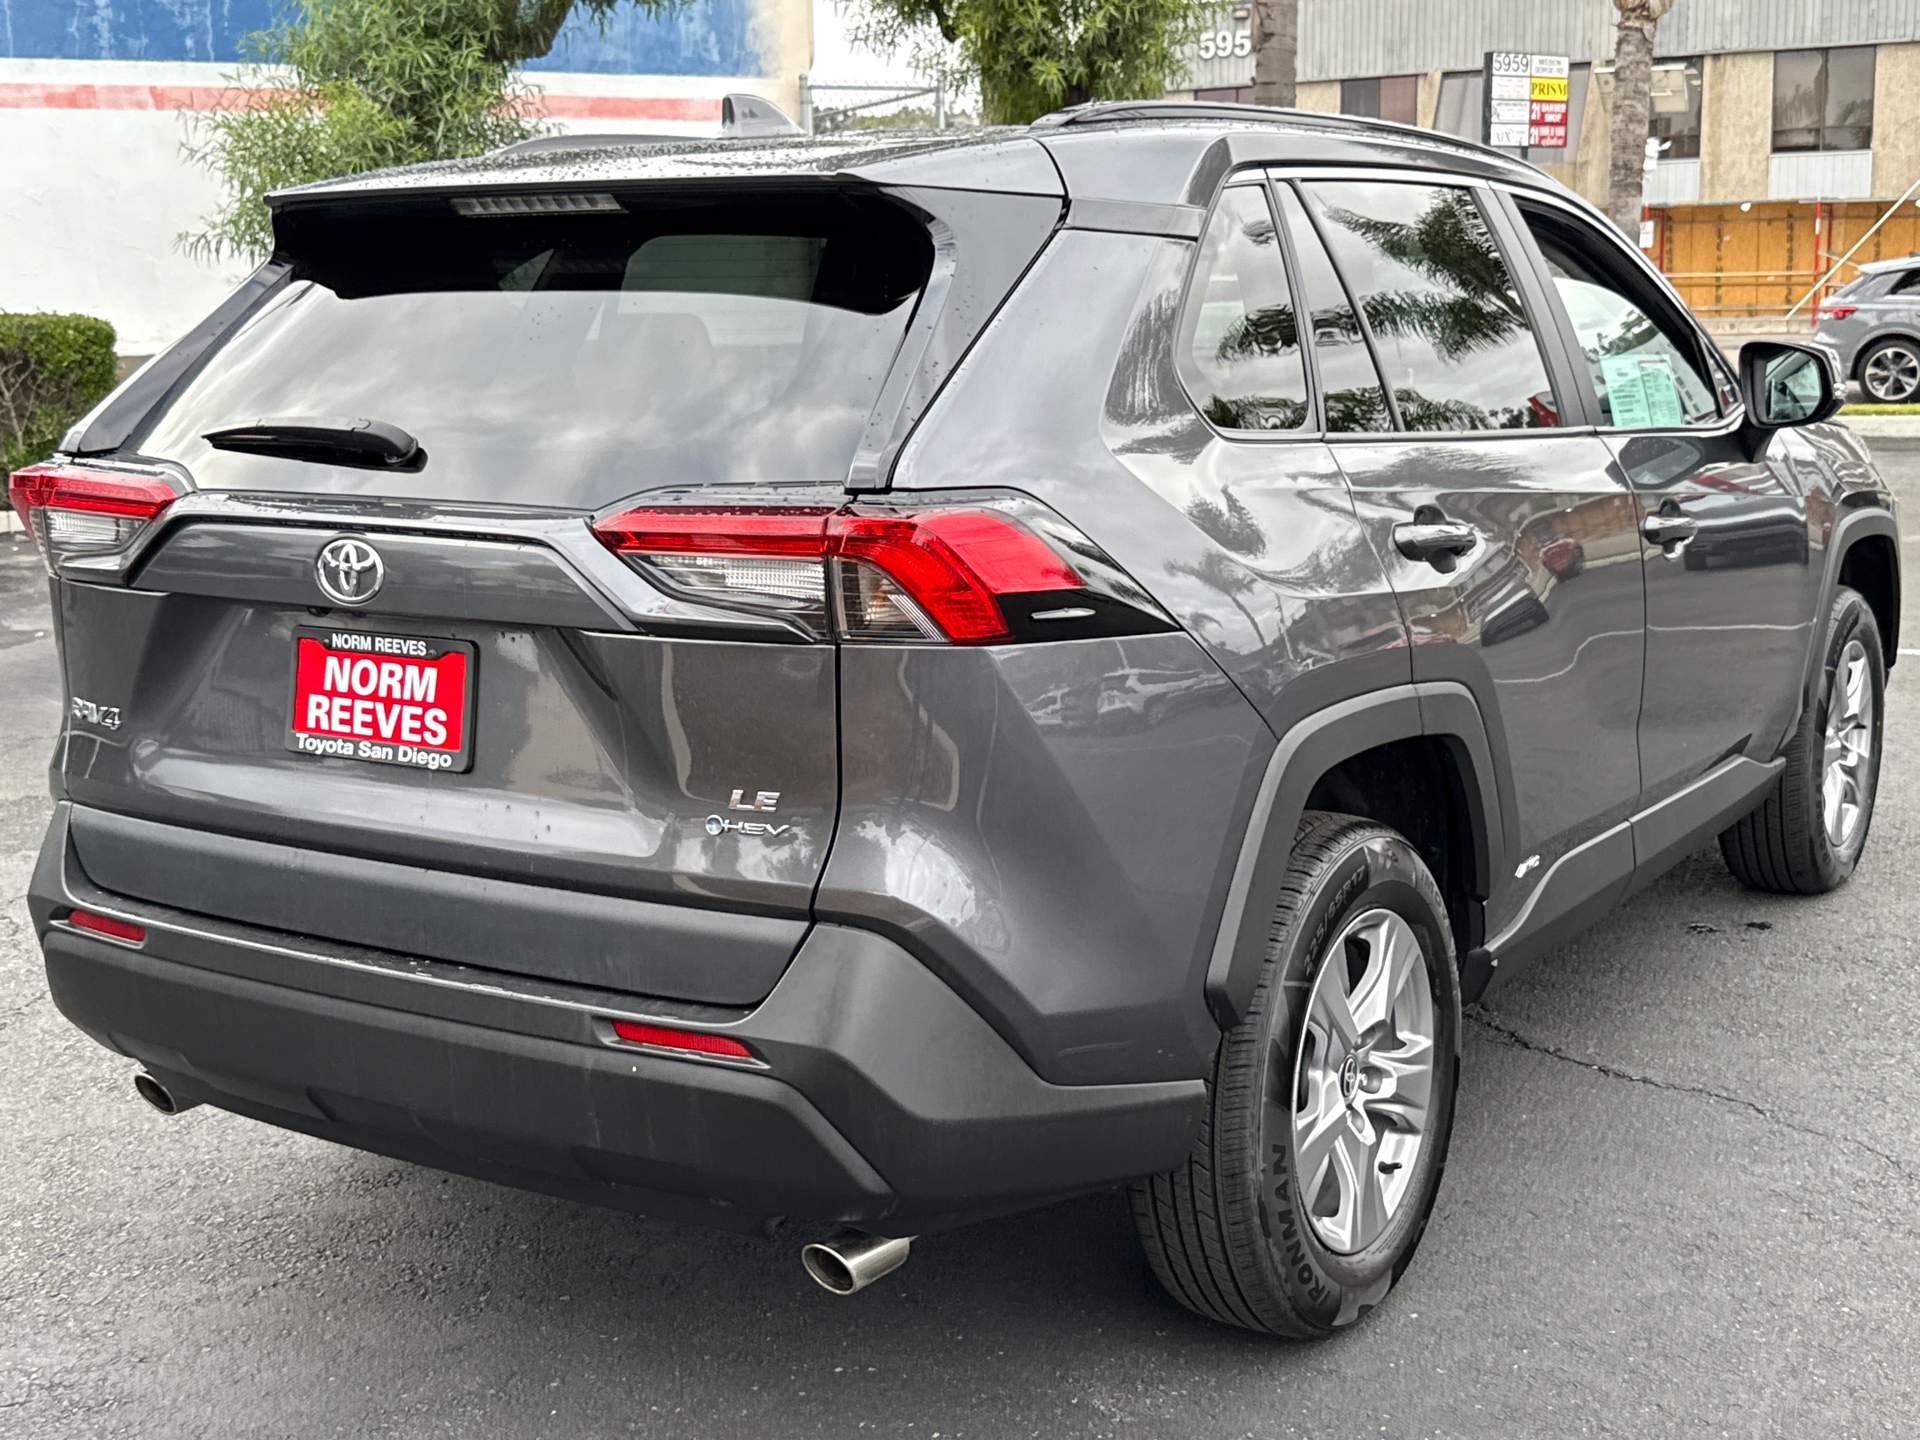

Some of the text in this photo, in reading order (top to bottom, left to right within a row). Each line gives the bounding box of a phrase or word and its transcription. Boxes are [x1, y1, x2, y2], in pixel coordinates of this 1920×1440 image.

[1493, 53, 1529, 73] 5959
[1531, 82, 1567, 96] PRISM
[331, 633, 427, 657] NORM REEVES
[323, 656, 438, 703] NORM
[306, 693, 448, 746] REEVES
[295, 733, 452, 769] Toyota San Diego
[728, 788, 781, 813] LE
[1271, 1144, 1332, 1305] IRONMAN
